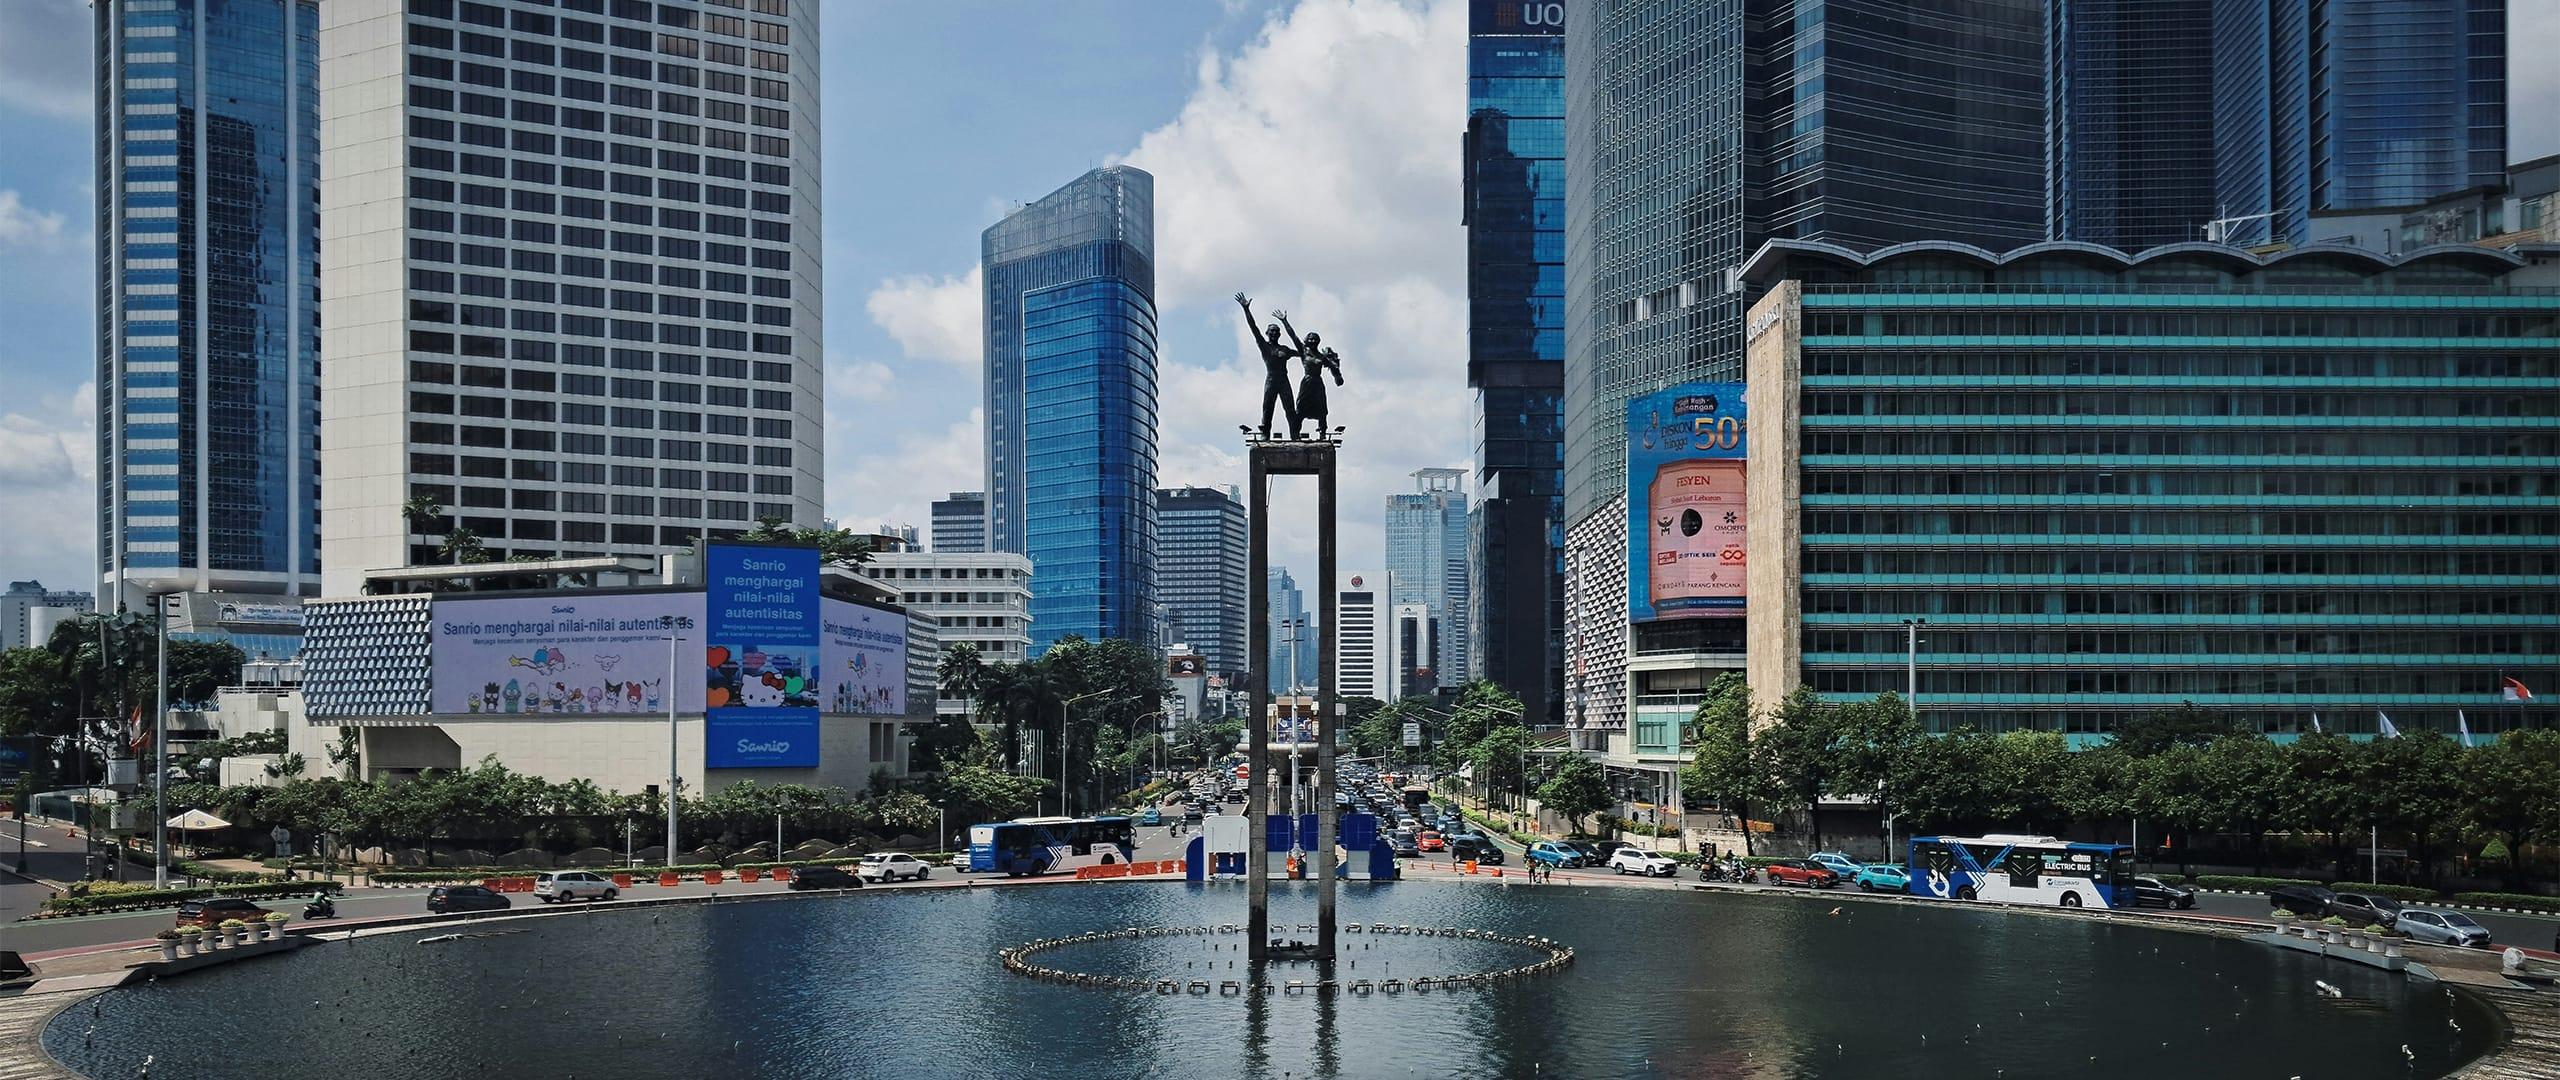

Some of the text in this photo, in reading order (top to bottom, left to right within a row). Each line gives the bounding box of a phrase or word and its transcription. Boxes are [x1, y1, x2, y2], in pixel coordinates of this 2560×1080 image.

[1661, 421, 1693, 437] DISKON
[1676, 476, 1711, 487] FESYEN
[742, 559, 786, 572] Sanrio
[724, 576, 804, 590] menghargai
[734, 592, 795, 603] nilai-nilai
[725, 607, 803, 620] autentisitas
[443, 616, 694, 637] Sanrio menghargai nilai-nilai autentisias
[737, 739, 790, 753] Sanrio
[2044, 862, 2091, 871] ELECTRIC BUS
